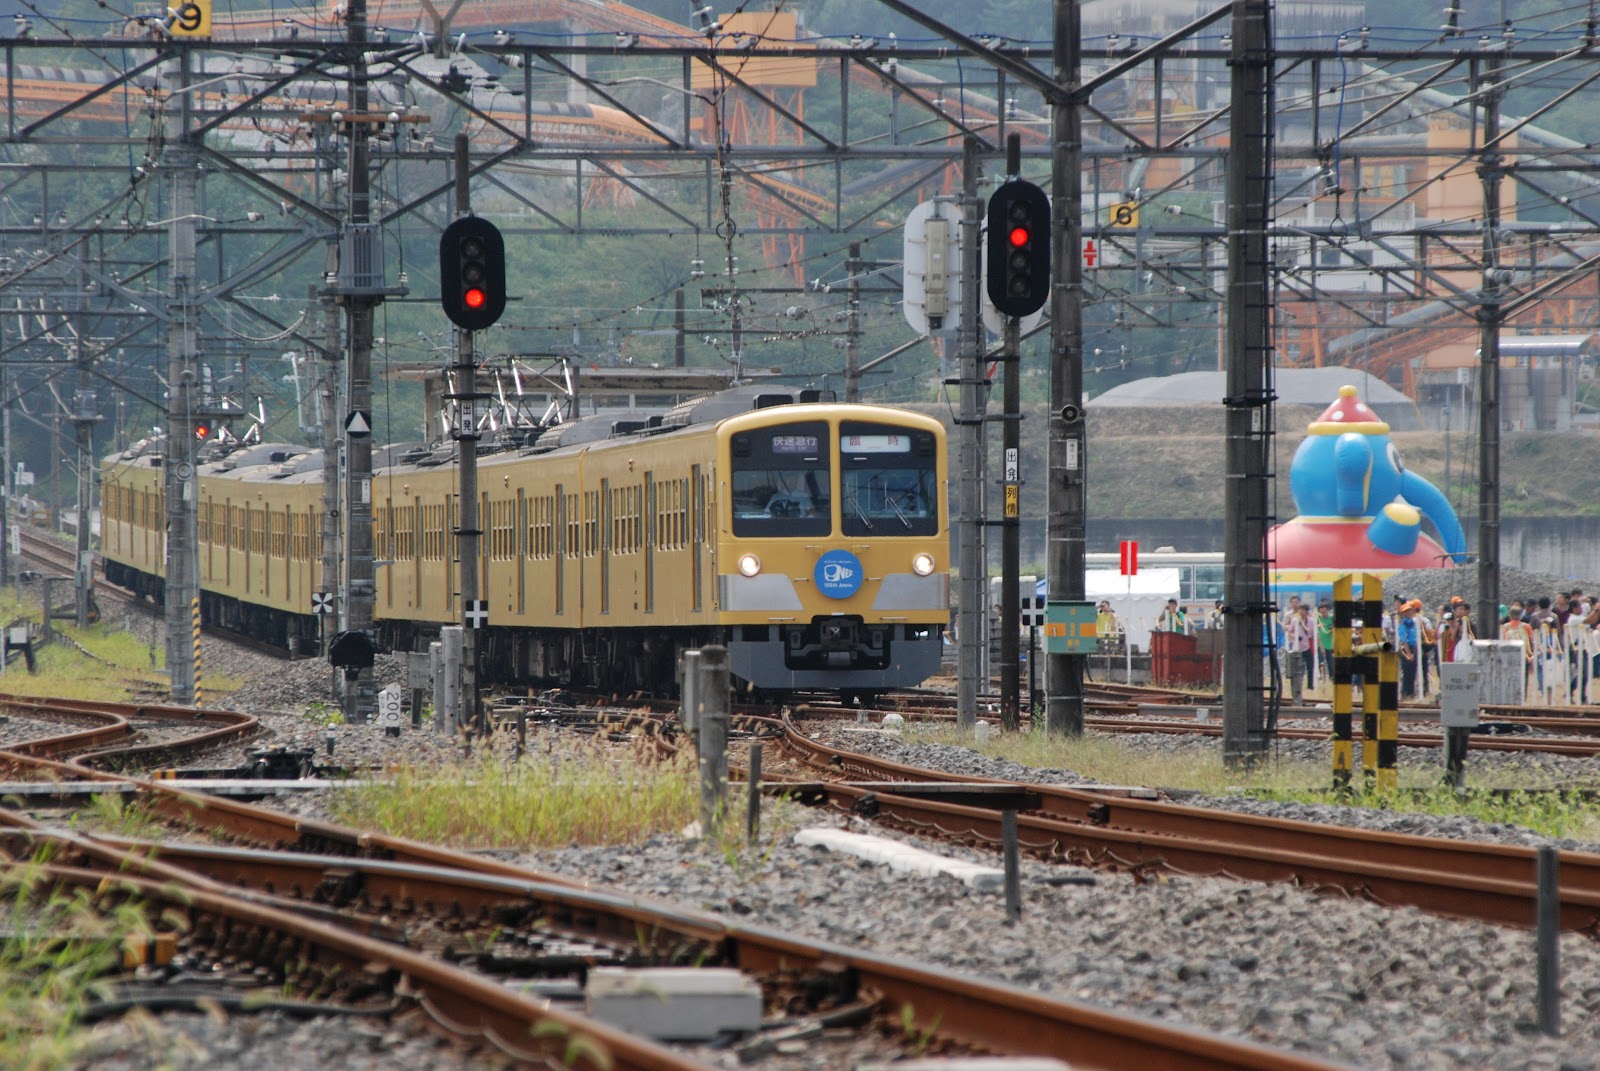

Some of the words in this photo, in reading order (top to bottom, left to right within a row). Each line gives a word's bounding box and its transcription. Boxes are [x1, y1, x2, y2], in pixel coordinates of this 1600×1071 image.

[178, 3, 202, 31] 9
[463, 403, 471, 431] 出発
[773, 436, 816, 446] 快速急行
[386, 691, 399, 721] 200
